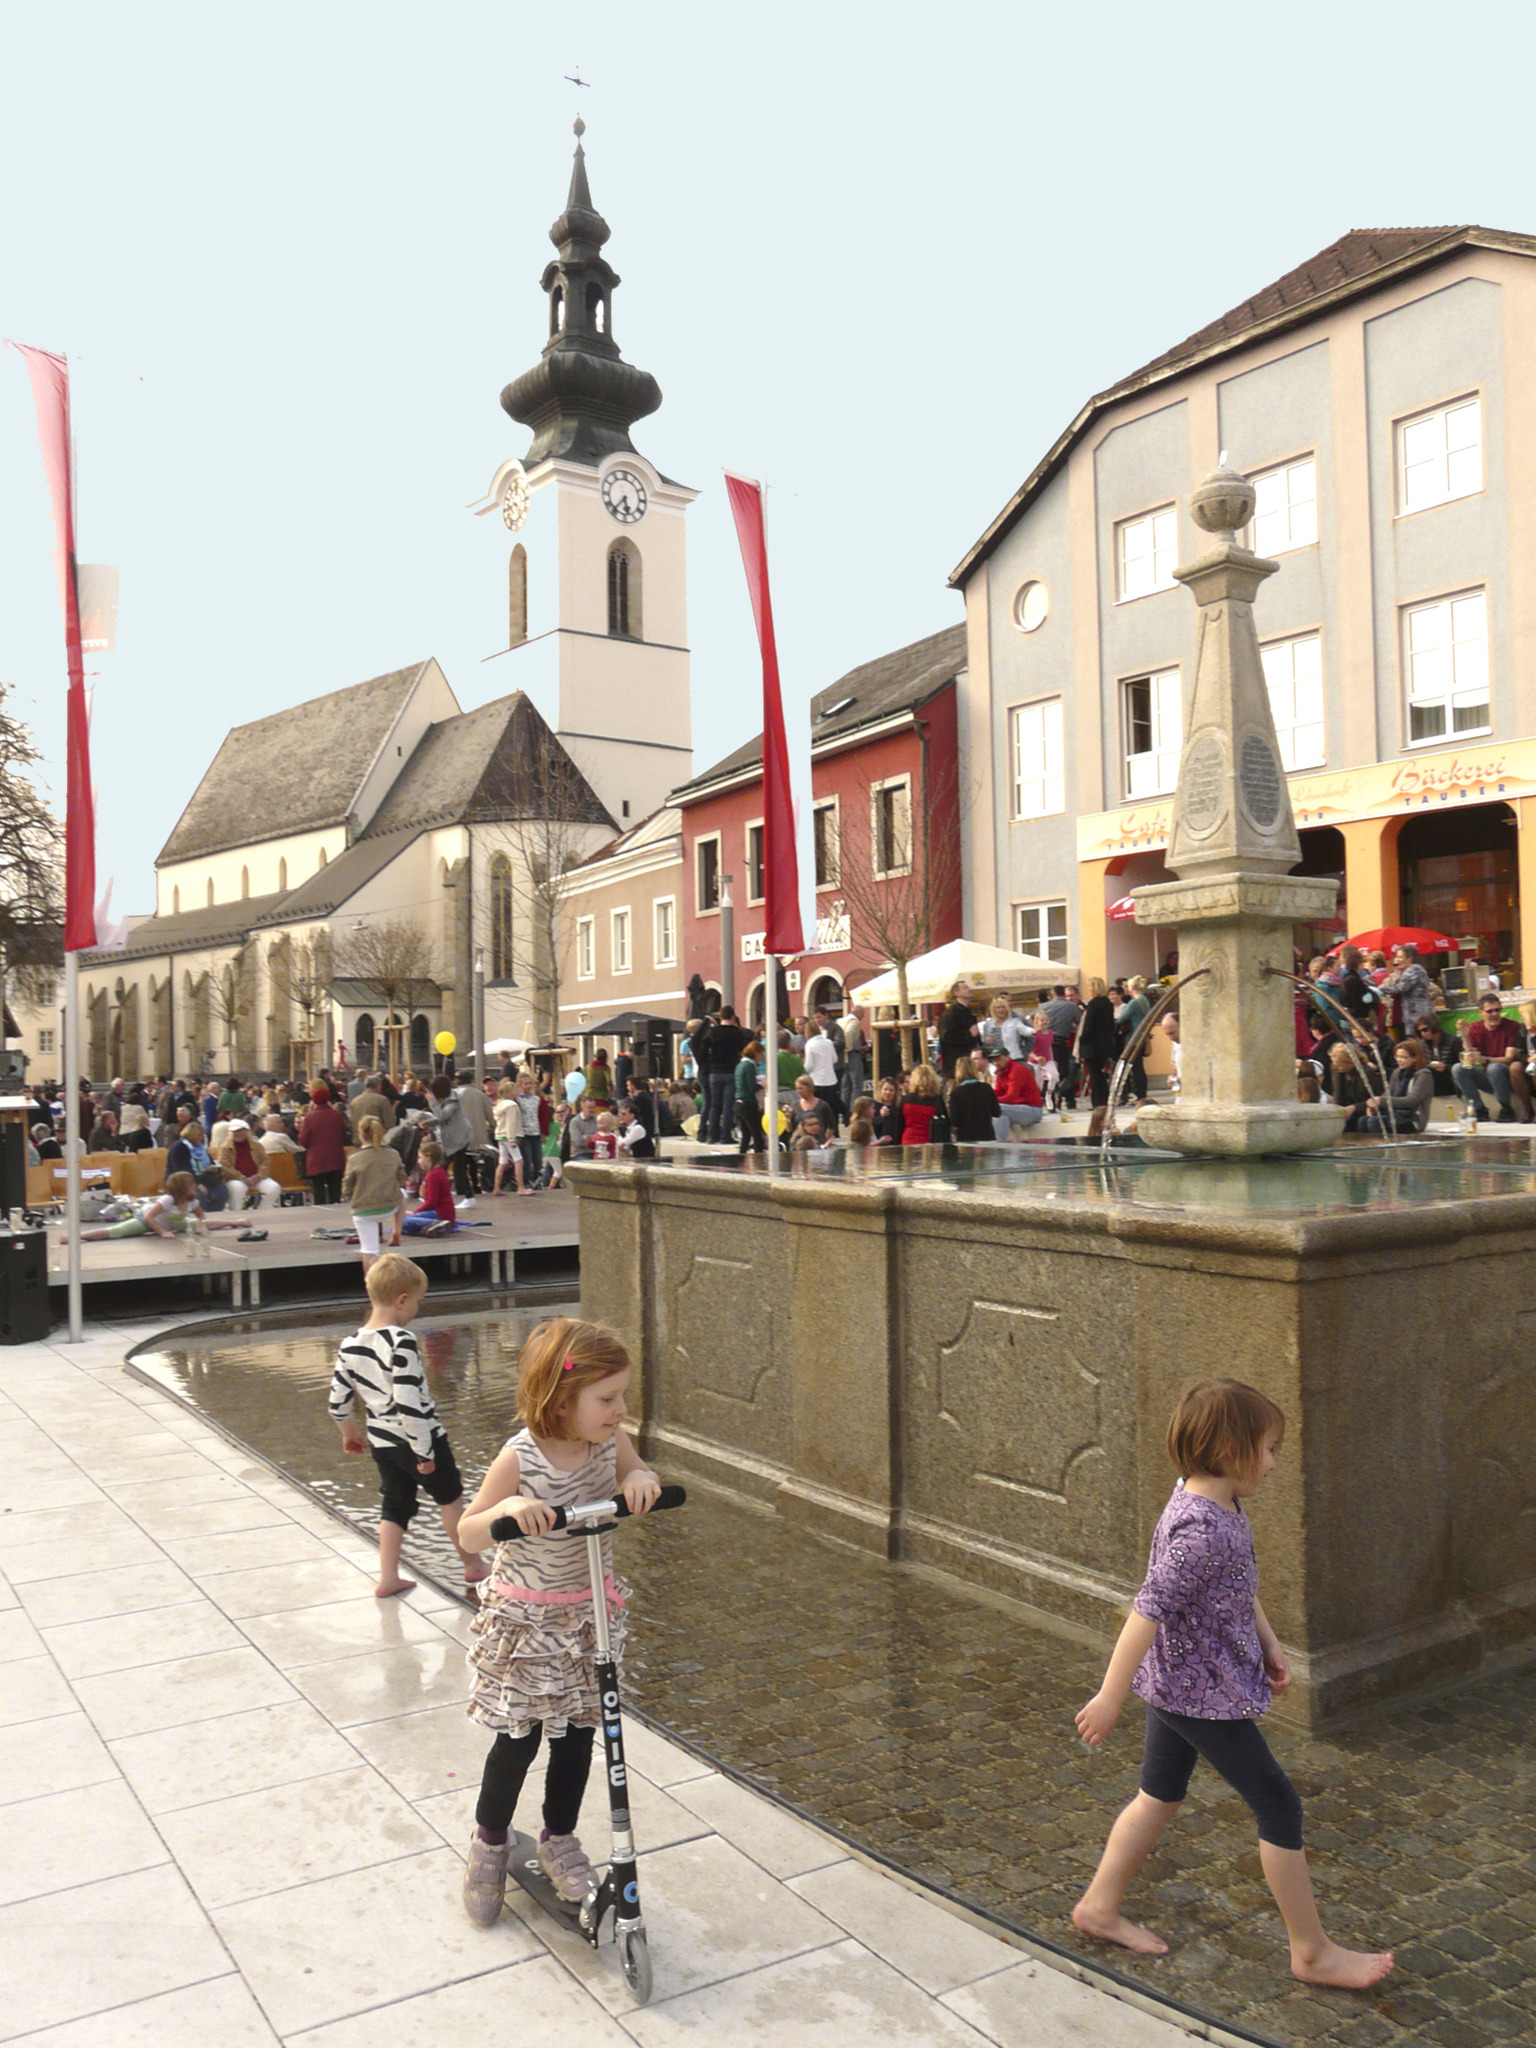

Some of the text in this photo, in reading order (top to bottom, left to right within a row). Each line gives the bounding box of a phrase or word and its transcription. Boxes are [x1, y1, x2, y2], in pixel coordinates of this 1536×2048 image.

[1391, 756, 1506, 792] Bäckerei
[1405, 783, 1506, 807] TAUBER
[1107, 835, 1165, 851] TAUBE
[603, 1690, 627, 1787] micro
